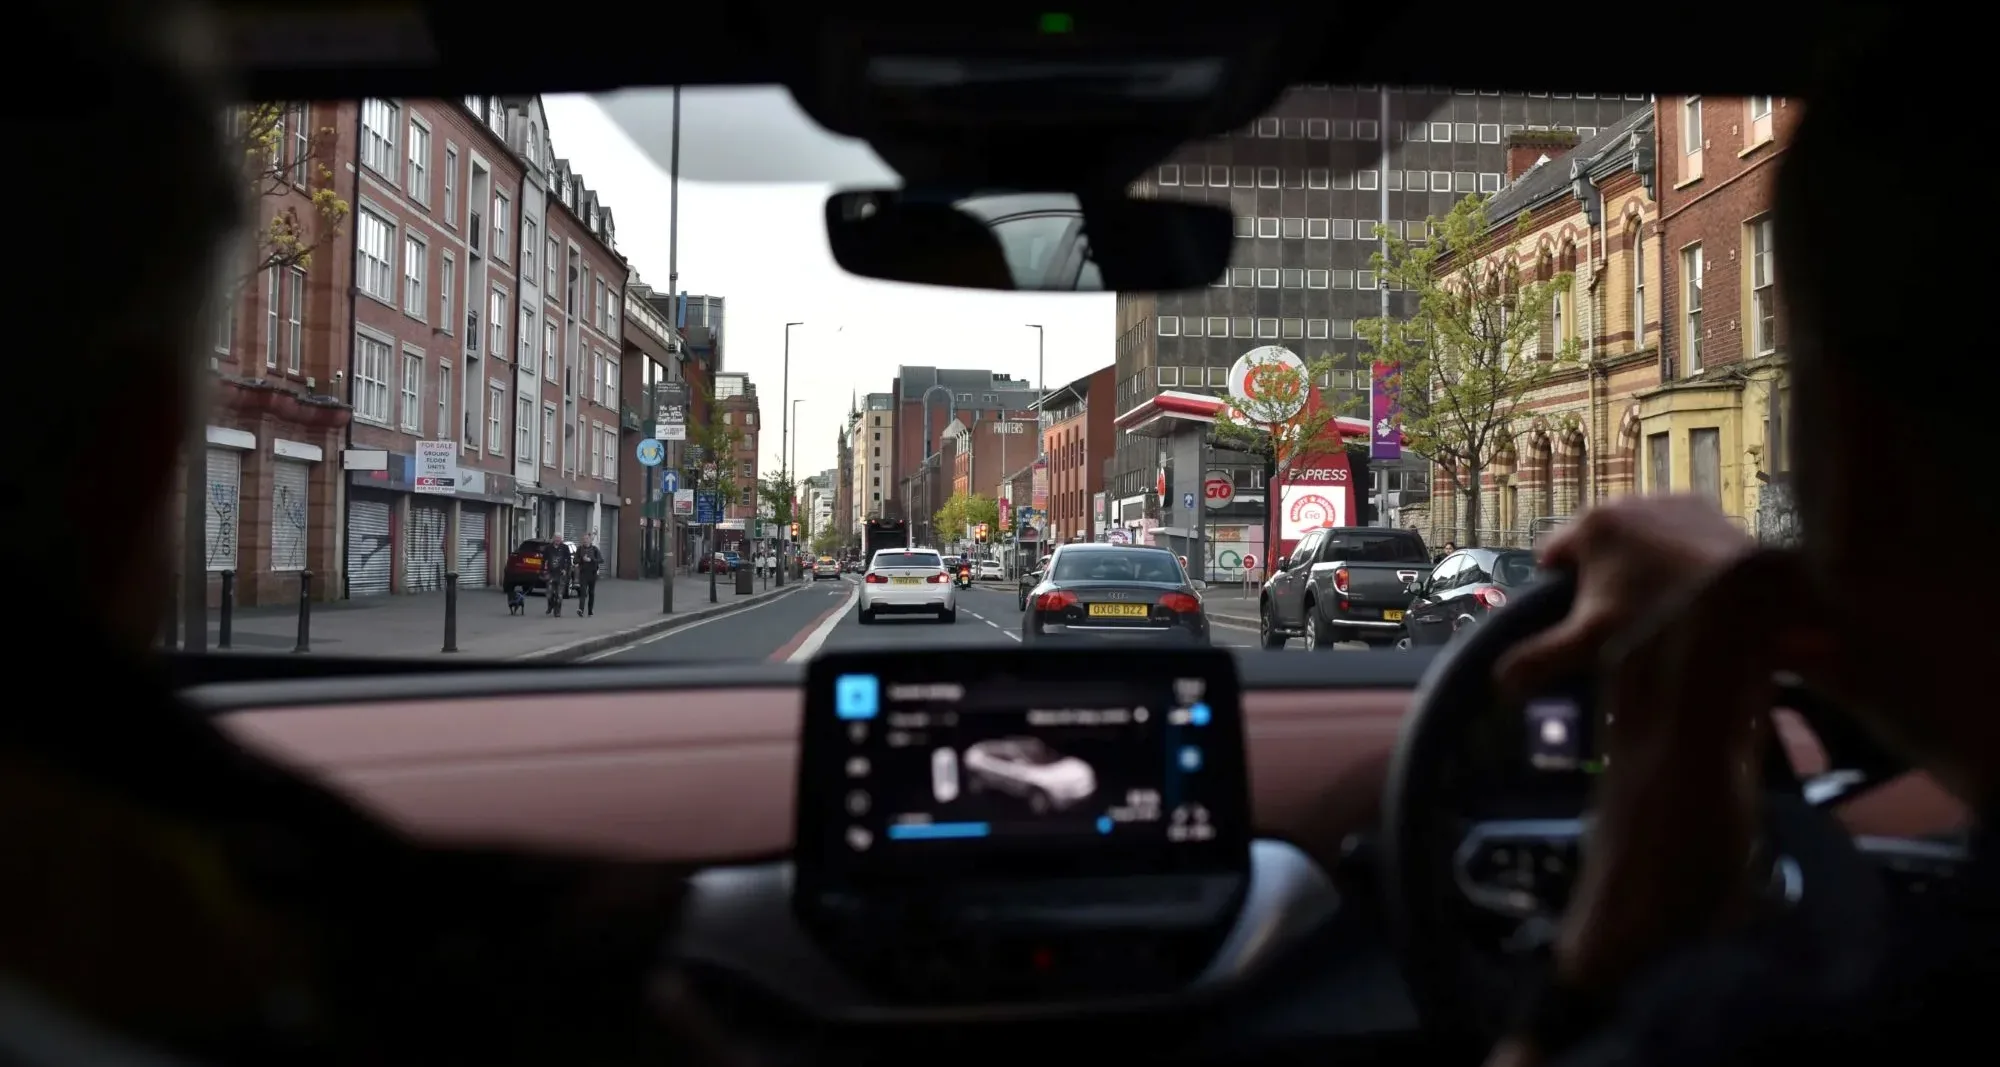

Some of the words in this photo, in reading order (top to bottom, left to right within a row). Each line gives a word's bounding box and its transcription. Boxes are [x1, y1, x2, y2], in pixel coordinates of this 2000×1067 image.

[993, 422, 1024, 434] PRINTERS
[1289, 468, 1348, 481] EXPRESS
[1093, 605, 1121, 615] OX06
[1123, 605, 1143, 615] DZZ
